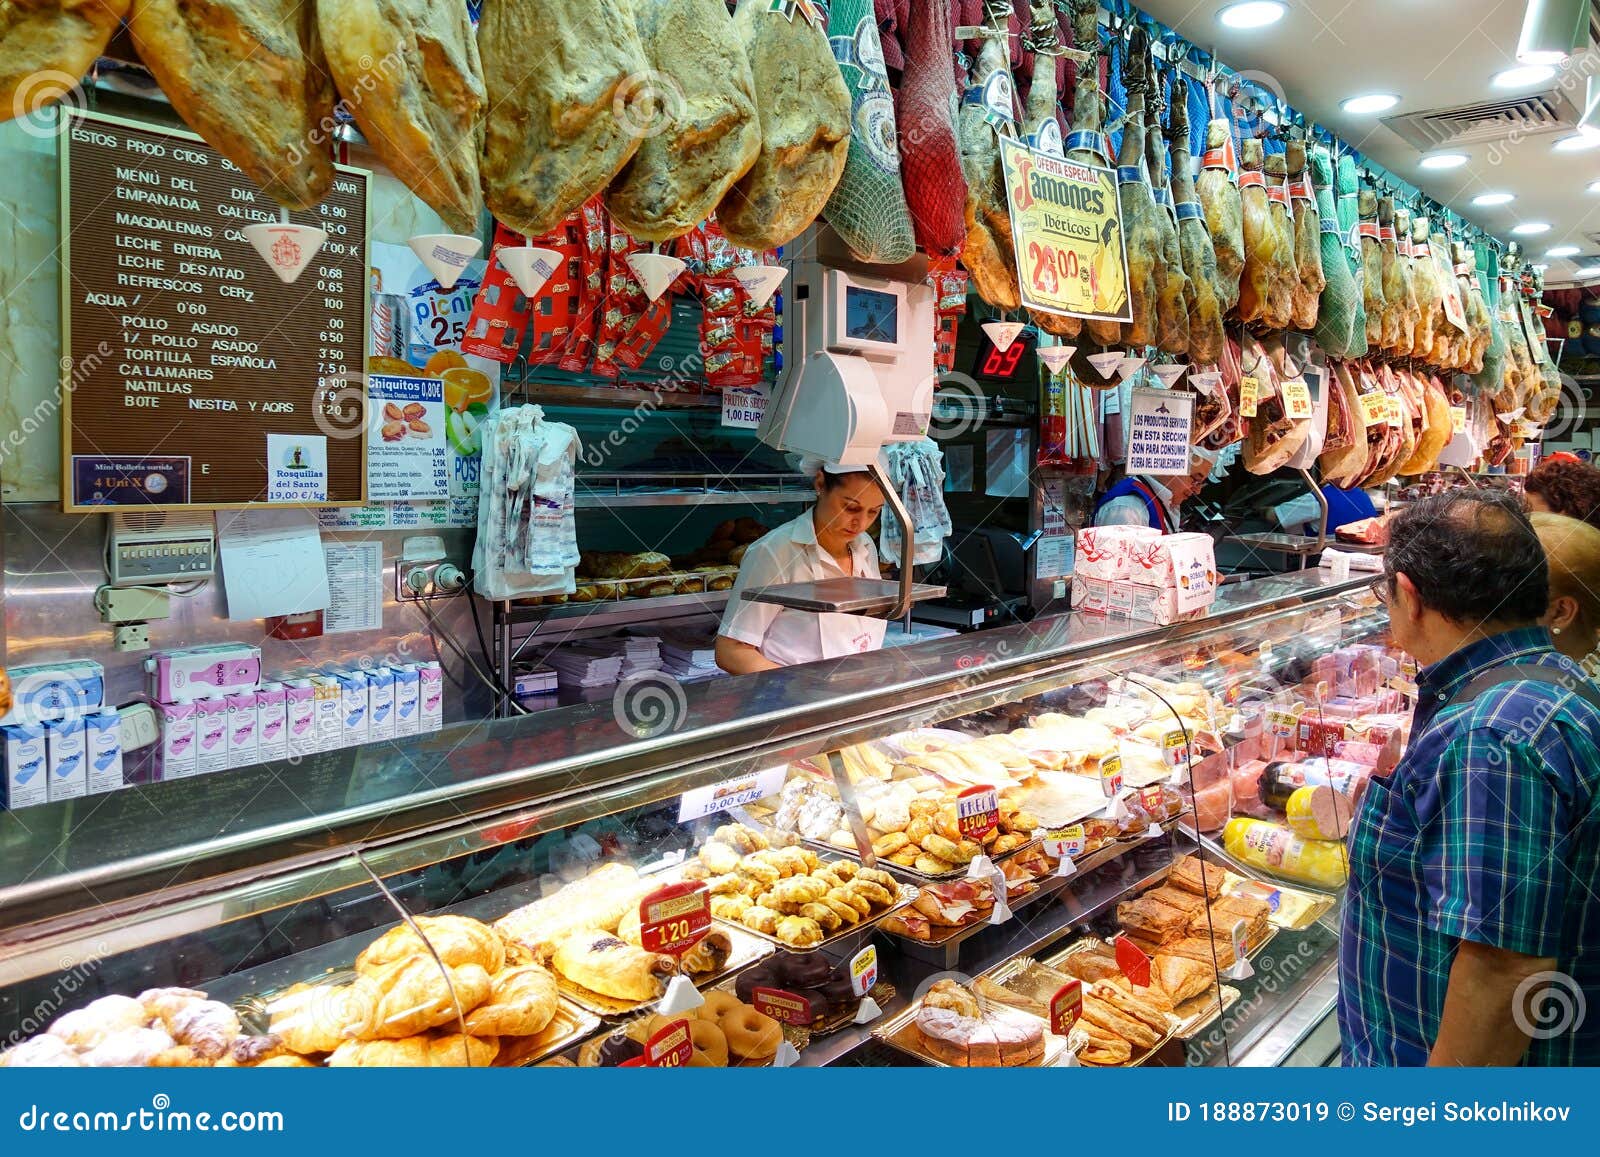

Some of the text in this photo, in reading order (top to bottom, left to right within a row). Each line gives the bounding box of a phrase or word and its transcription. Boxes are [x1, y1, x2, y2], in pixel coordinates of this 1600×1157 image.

[71, 129, 117, 148] ESTOS
[126, 139, 165, 157] PROD
[173, 149, 208, 165] CTOS
[1036, 158, 1098, 184] OFERTA ESPECIAL
[1014, 153, 1105, 215] Jamones
[116, 186, 200, 211] EMPANADA
[217, 204, 277, 224] GALLEGA
[171, 177, 198, 192] DEL
[231, 188, 255, 202] DIA
[320, 204, 346, 218] 8.90
[1044, 213, 1091, 236] Ibéricos
[115, 212, 212, 238] MAGDALENAS
[350, 246, 359, 256] K
[115, 235, 162, 252] LECHE
[174, 243, 222, 260] ENTERA
[118, 254, 165, 271] LECHE
[85, 293, 127, 307] AGUA
[118, 273, 202, 293] REFRESCOS
[324, 298, 343, 310] 100
[122, 316, 168, 330] POLLO
[191, 322, 238, 336] ASADO
[431, 317, 468, 347] 2,5
[152, 335, 198, 349] POLLO
[212, 340, 258, 353] ASADO
[125, 348, 192, 364] TORTILLA
[210, 354, 276, 370] ESPAÑOLA
[984, 341, 1025, 375] 69
[126, 380, 192, 395] NATILLAS
[368, 377, 441, 400] Chiquitos 0,80€
[125, 395, 160, 408] BOTE
[189, 398, 238, 411] NESTEA
[248, 401, 257, 411] Y
[724, 394, 770, 409] FRUTOS SECO
[726, 409, 743, 421] 1,00
[1134, 414, 1188, 429] LOS PRODUCTOS SERVIDOS
[1133, 430, 1187, 442] EN ESTA SECCION
[1132, 443, 1186, 456] SON PARA CONSUMIR
[94, 462, 114, 472] Mini
[202, 464, 210, 475] E
[1131, 457, 1145, 468] FUERA
[1145, 457, 1153, 469] DEL
[93, 478, 101, 488] 4
[131, 478, 142, 488] X
[276, 470, 323, 480] Rosquillas
[276, 480, 319, 488] del Santo
[270, 490, 325, 502] 19,00 €/kg
[216, 664, 224, 686] leche
[172, 737, 191, 745] leche
[703, 789, 763, 813] 19,00 €/kg
[659, 920, 689, 945] 1'20
